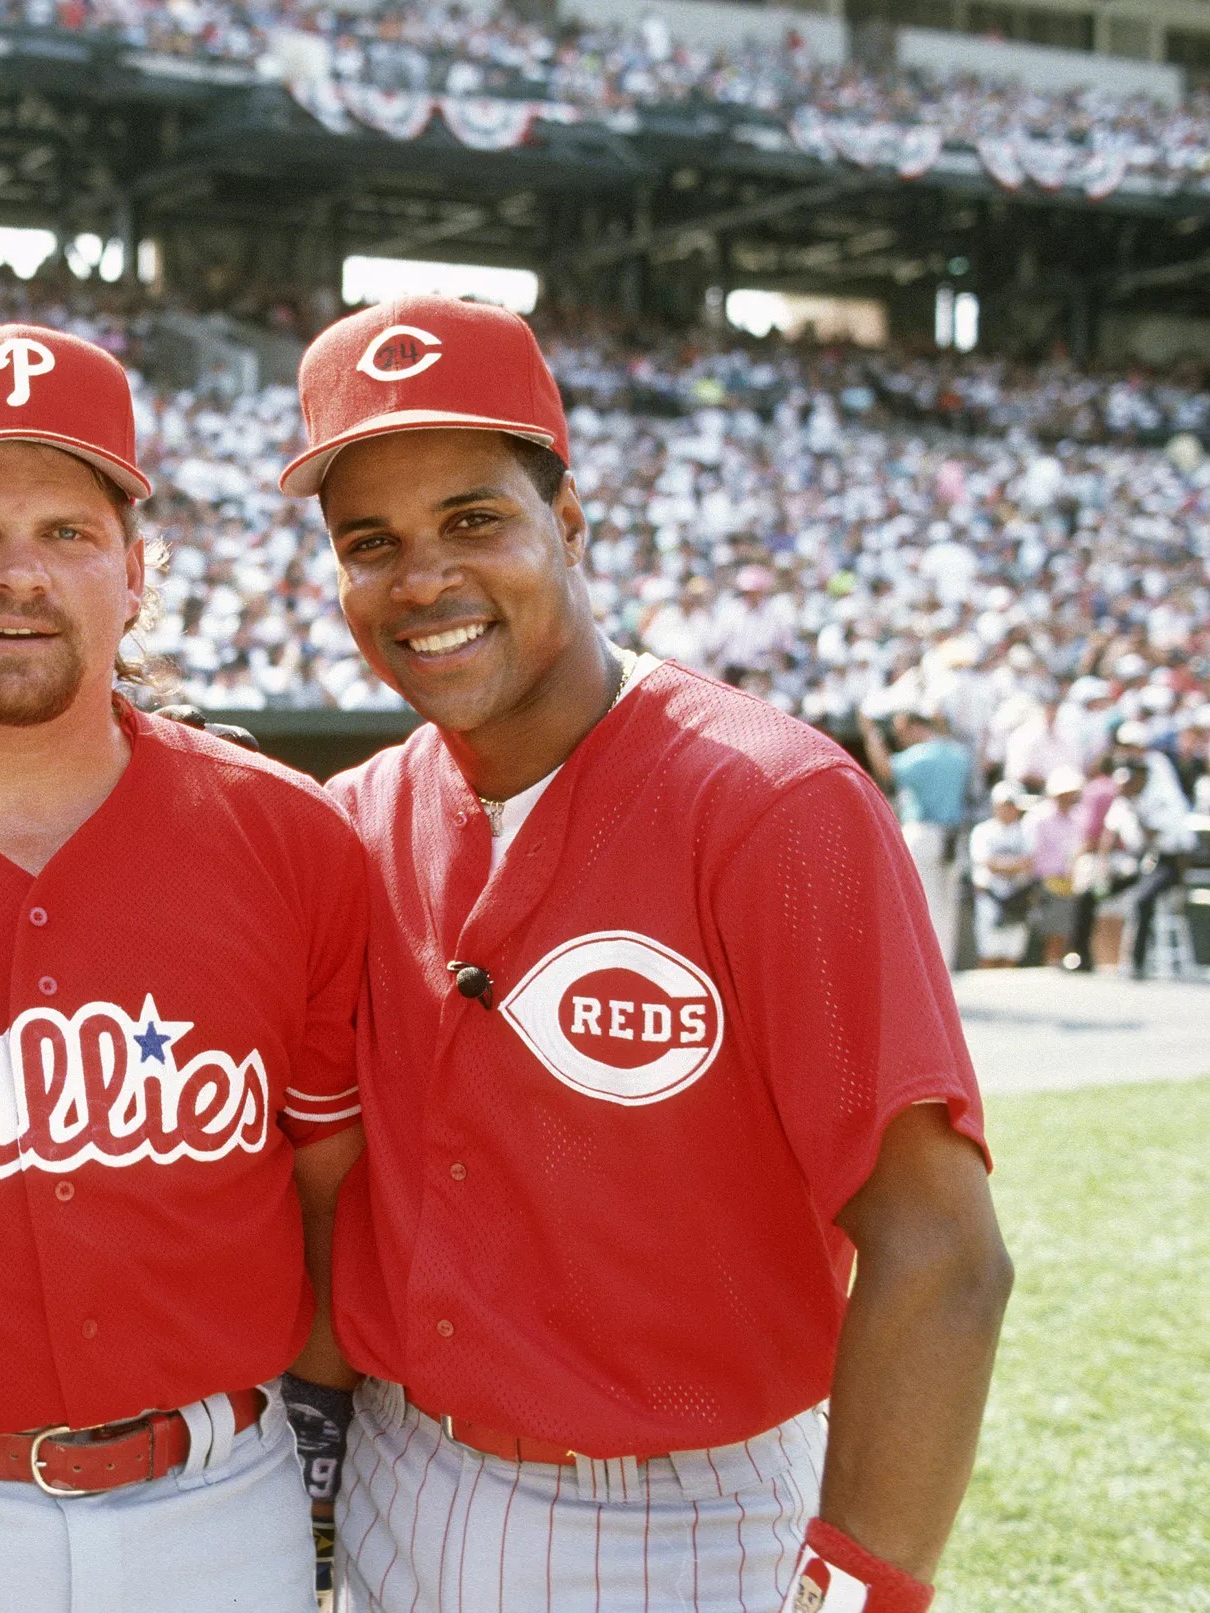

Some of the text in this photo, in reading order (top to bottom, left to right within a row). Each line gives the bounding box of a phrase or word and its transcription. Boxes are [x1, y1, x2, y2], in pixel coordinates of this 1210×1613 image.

[356, 325, 442, 382] C
[378, 342, 419, 370] 24
[571, 996, 706, 1043] REDS
[299, 1453, 338, 1498] 9
